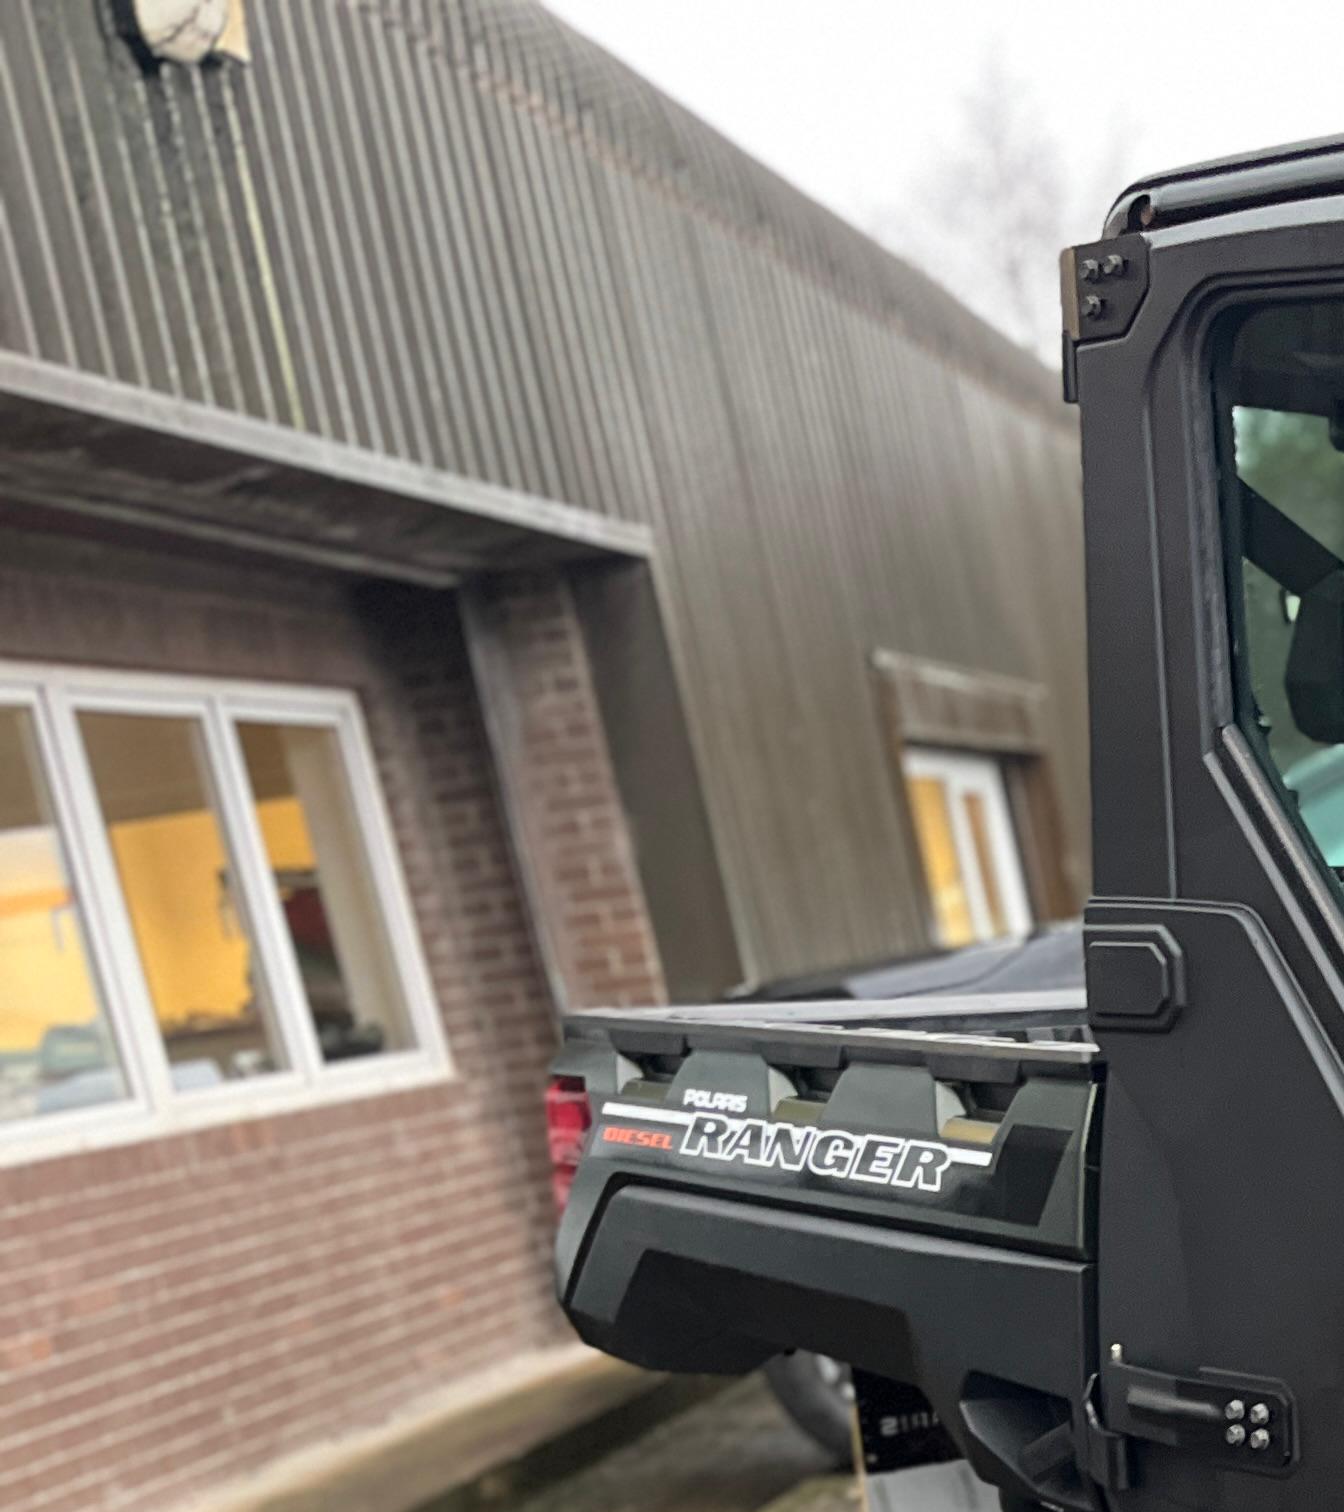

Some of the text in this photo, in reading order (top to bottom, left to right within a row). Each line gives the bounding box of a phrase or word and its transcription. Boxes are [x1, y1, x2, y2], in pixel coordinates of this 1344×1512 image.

[683, 1088, 748, 1113] POLARIS
[603, 1127, 673, 1150] DIESEL
[679, 1111, 951, 1192] RANGER
